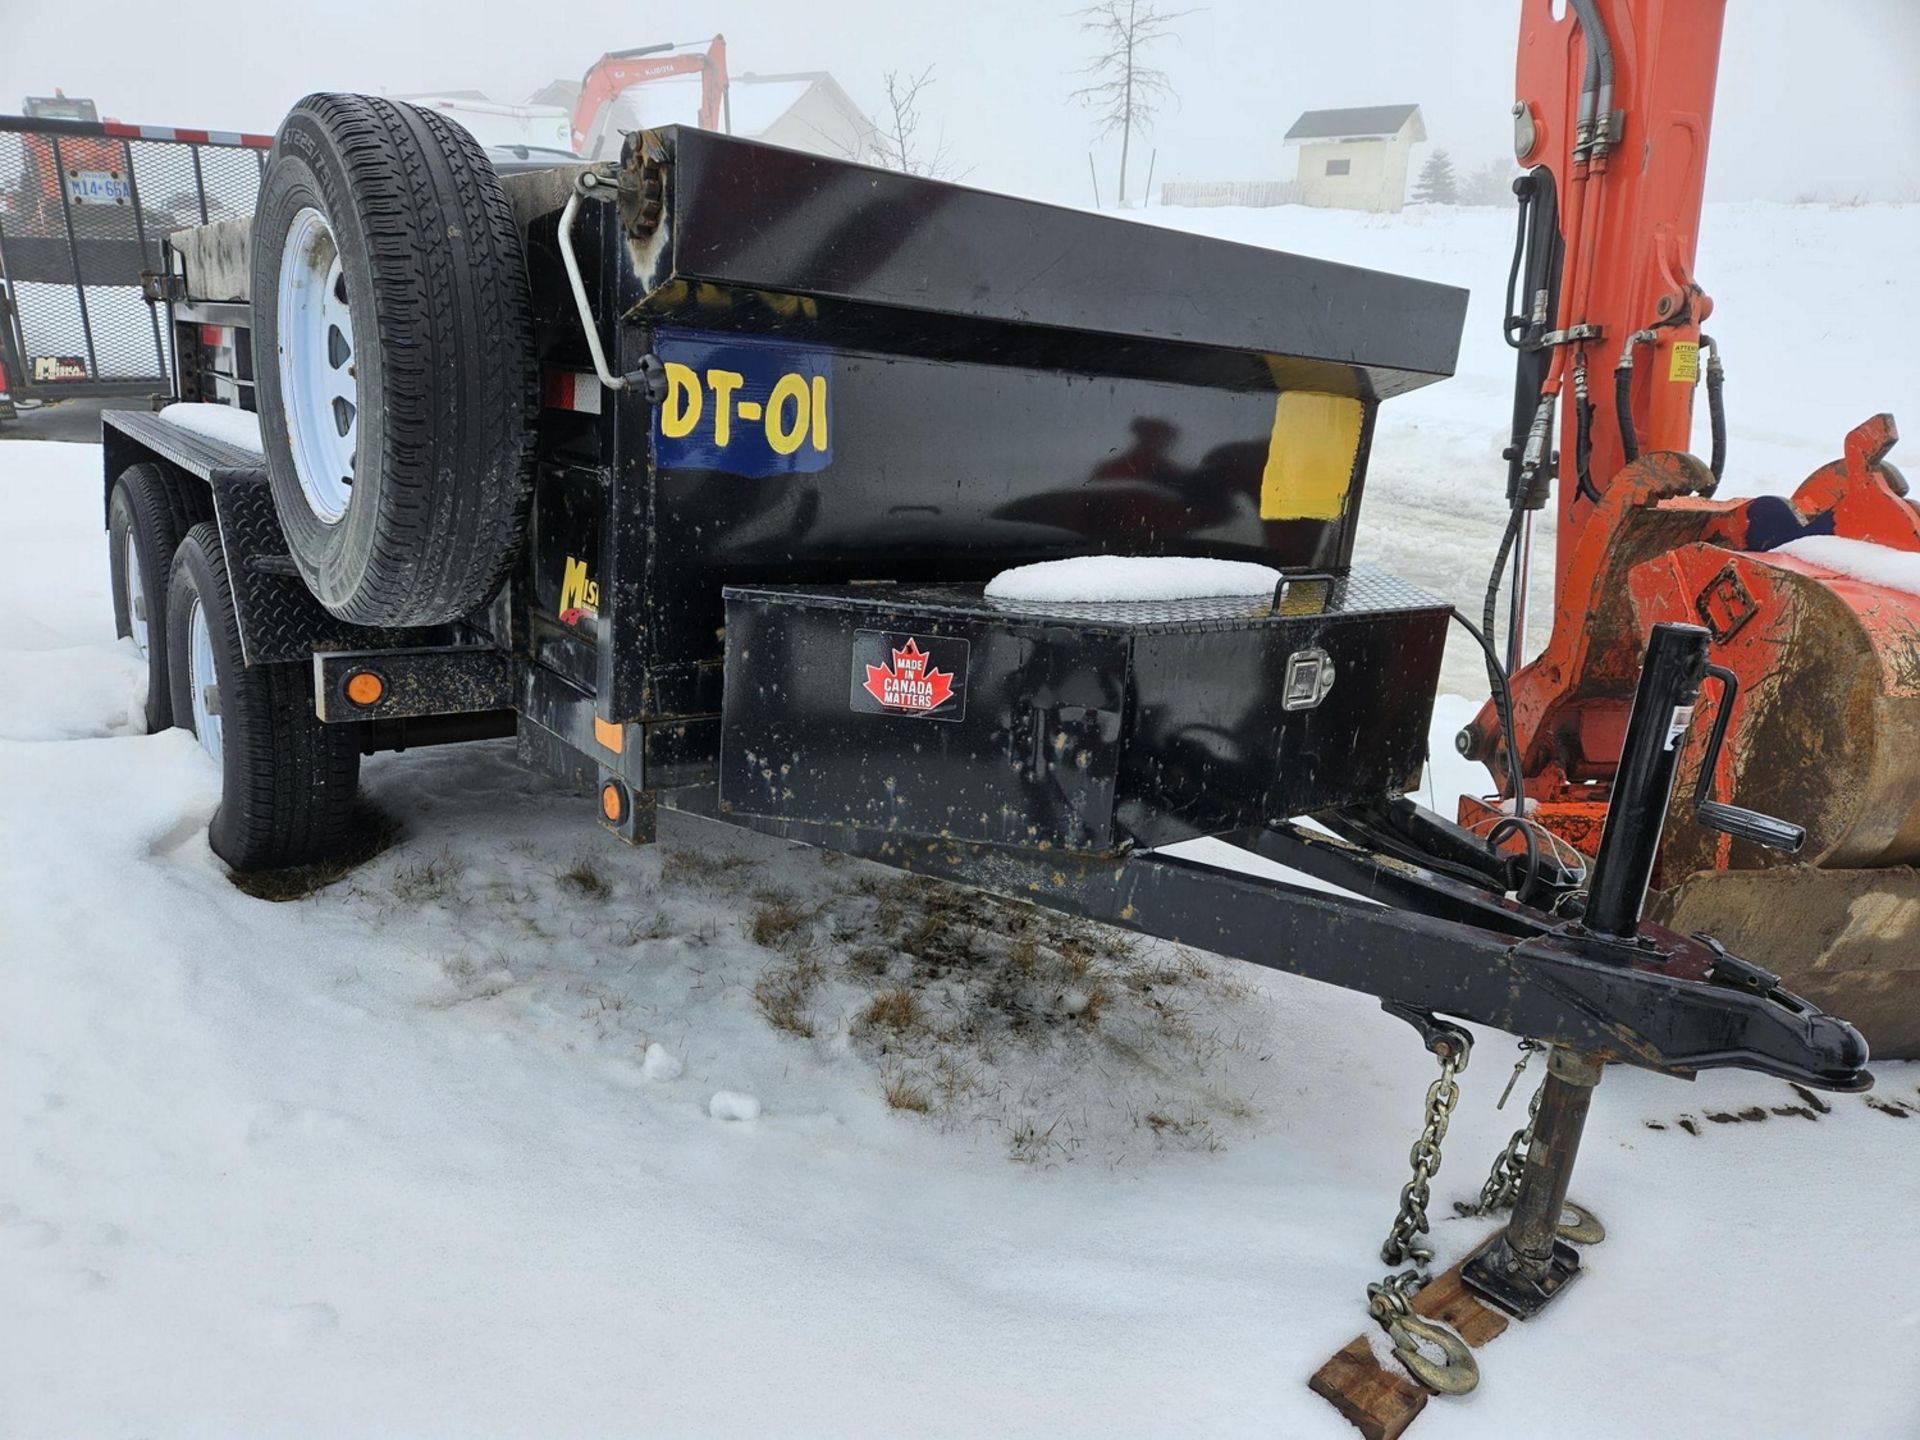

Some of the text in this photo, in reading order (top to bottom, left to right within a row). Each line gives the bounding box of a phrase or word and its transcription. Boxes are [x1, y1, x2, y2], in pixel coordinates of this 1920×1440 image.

[661, 362, 827, 455] DT-01
[560, 556, 599, 619] MIS
[898, 658, 923, 670] MADE
[904, 669, 915, 680] IN
[884, 678, 933, 695] CANADA
[884, 692, 931, 707] MATTERS
